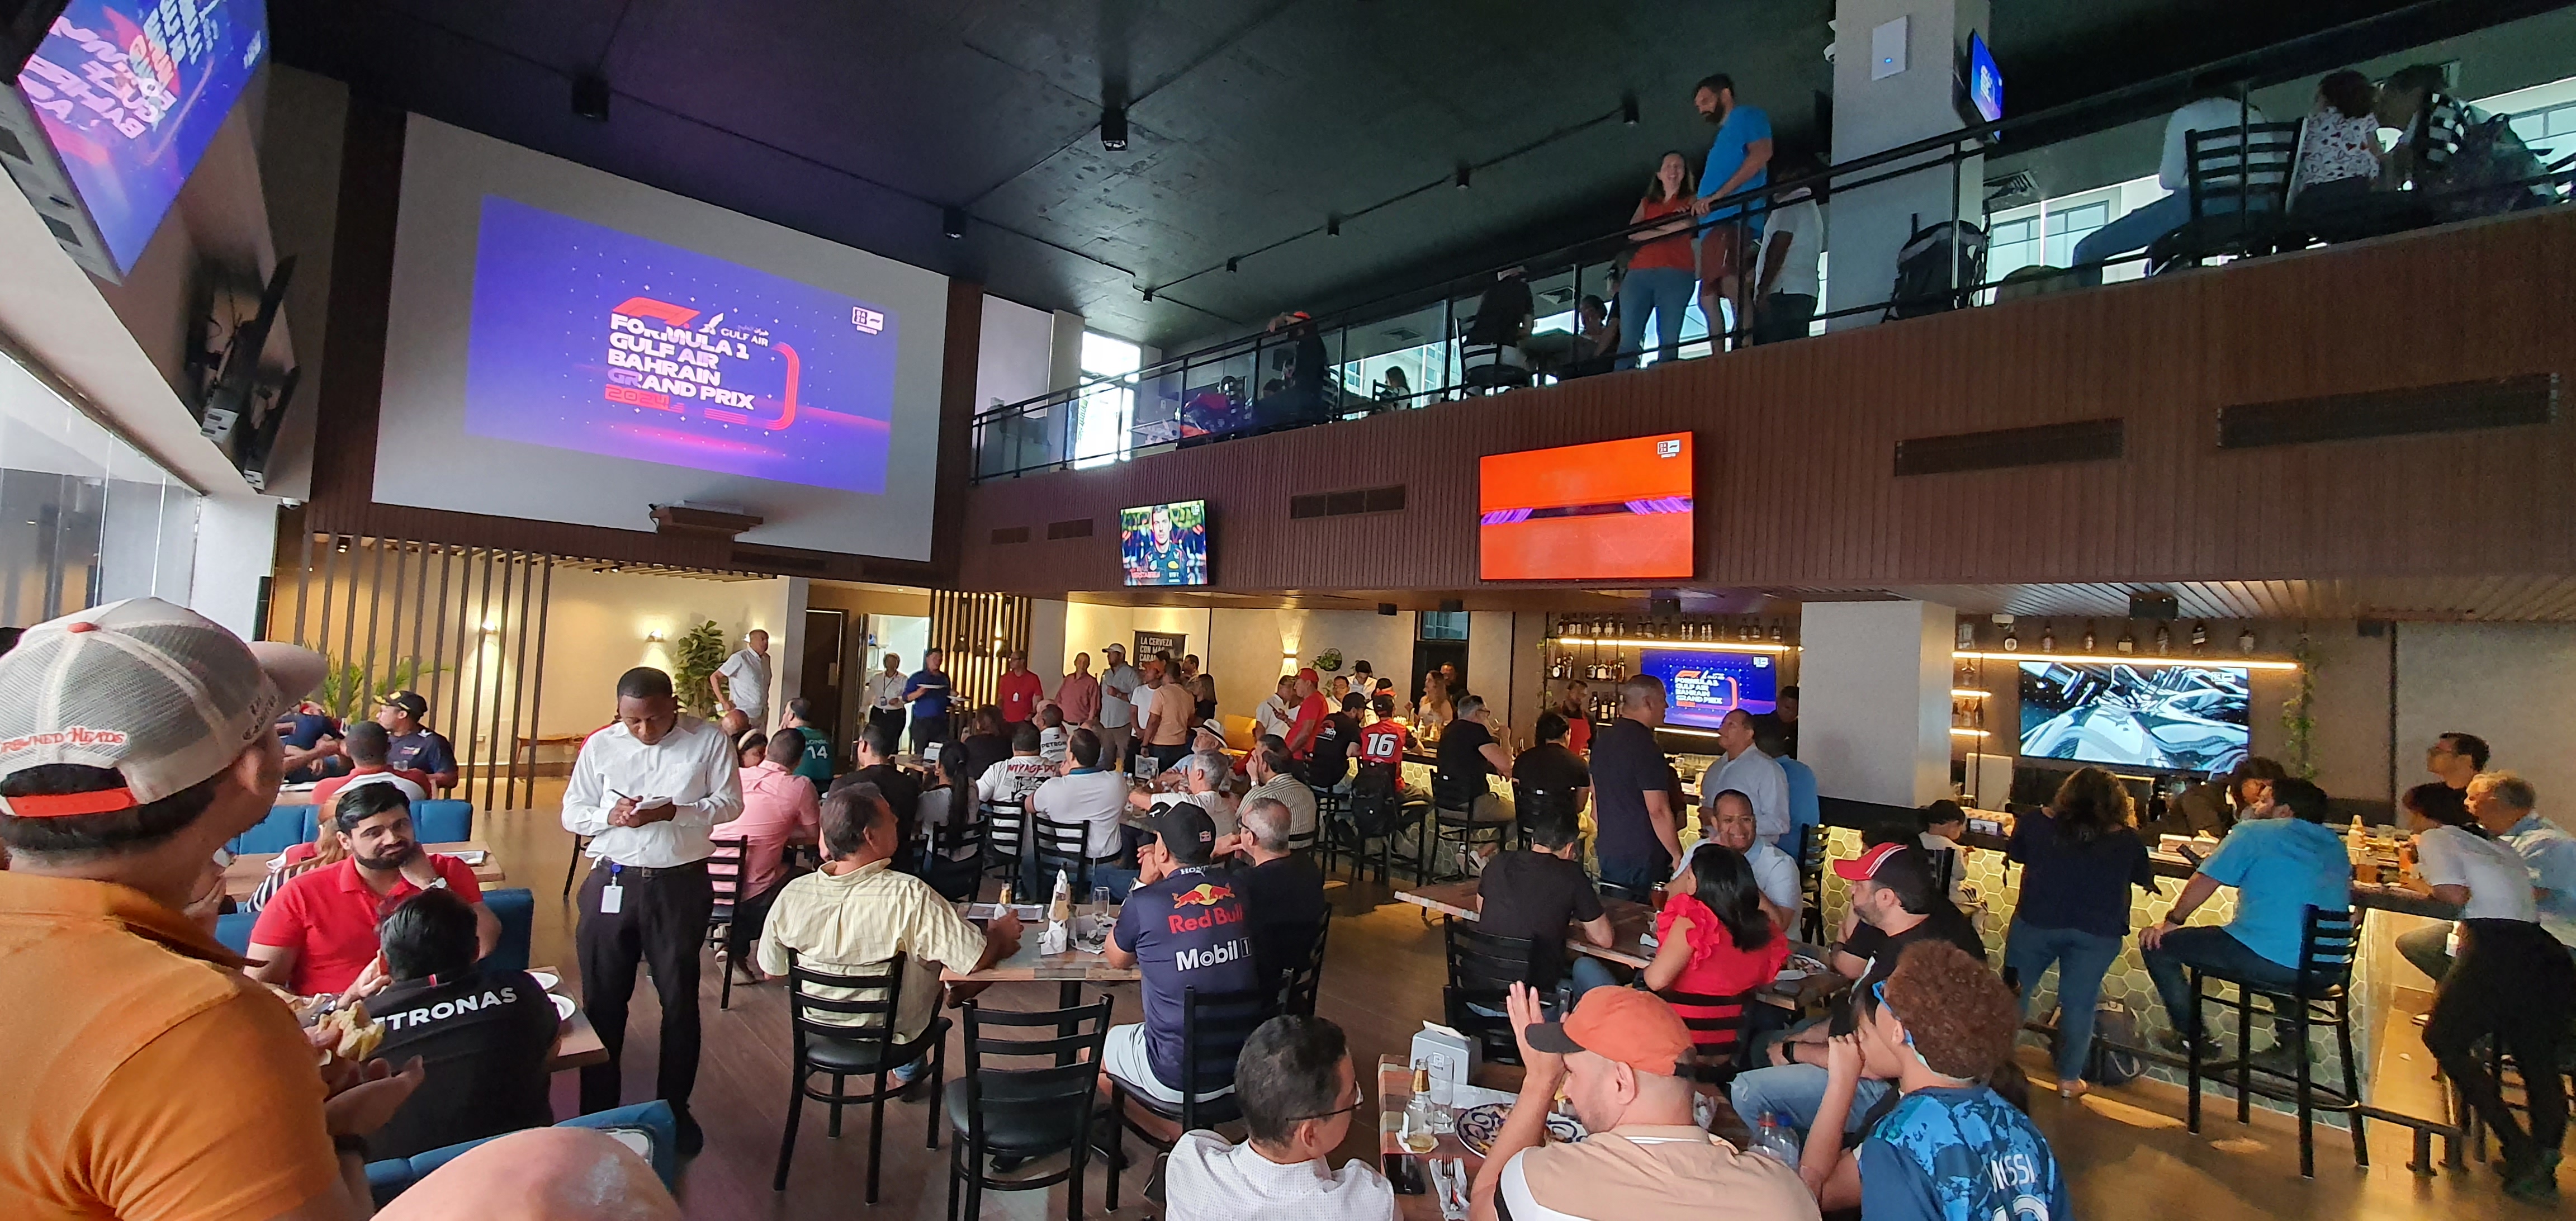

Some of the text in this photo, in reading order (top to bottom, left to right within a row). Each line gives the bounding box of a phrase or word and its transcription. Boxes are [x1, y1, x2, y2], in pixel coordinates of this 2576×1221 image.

[610, 313, 732, 356] FORMULA
[736, 343, 750, 359] 1
[721, 328, 750, 341] GULF
[751, 335, 769, 347] AIR
[609, 332, 719, 370] GULF AIR
[608, 348, 721, 387] BAHRAIN
[607, 367, 756, 410] GRAND PRIX
[608, 387, 669, 409] 2024
[1140, 645, 1151, 654] CON
[1149, 637, 1173, 647] CERVEZA
[0, 732, 64, 753] ROWNED
[807, 745, 828, 759] 14
[1367, 733, 1398, 758] 16
[1168, 902, 1243, 934] Red Bull
[1176, 939, 1239, 972] Mobil
[371, 987, 517, 1031] TRONAS
